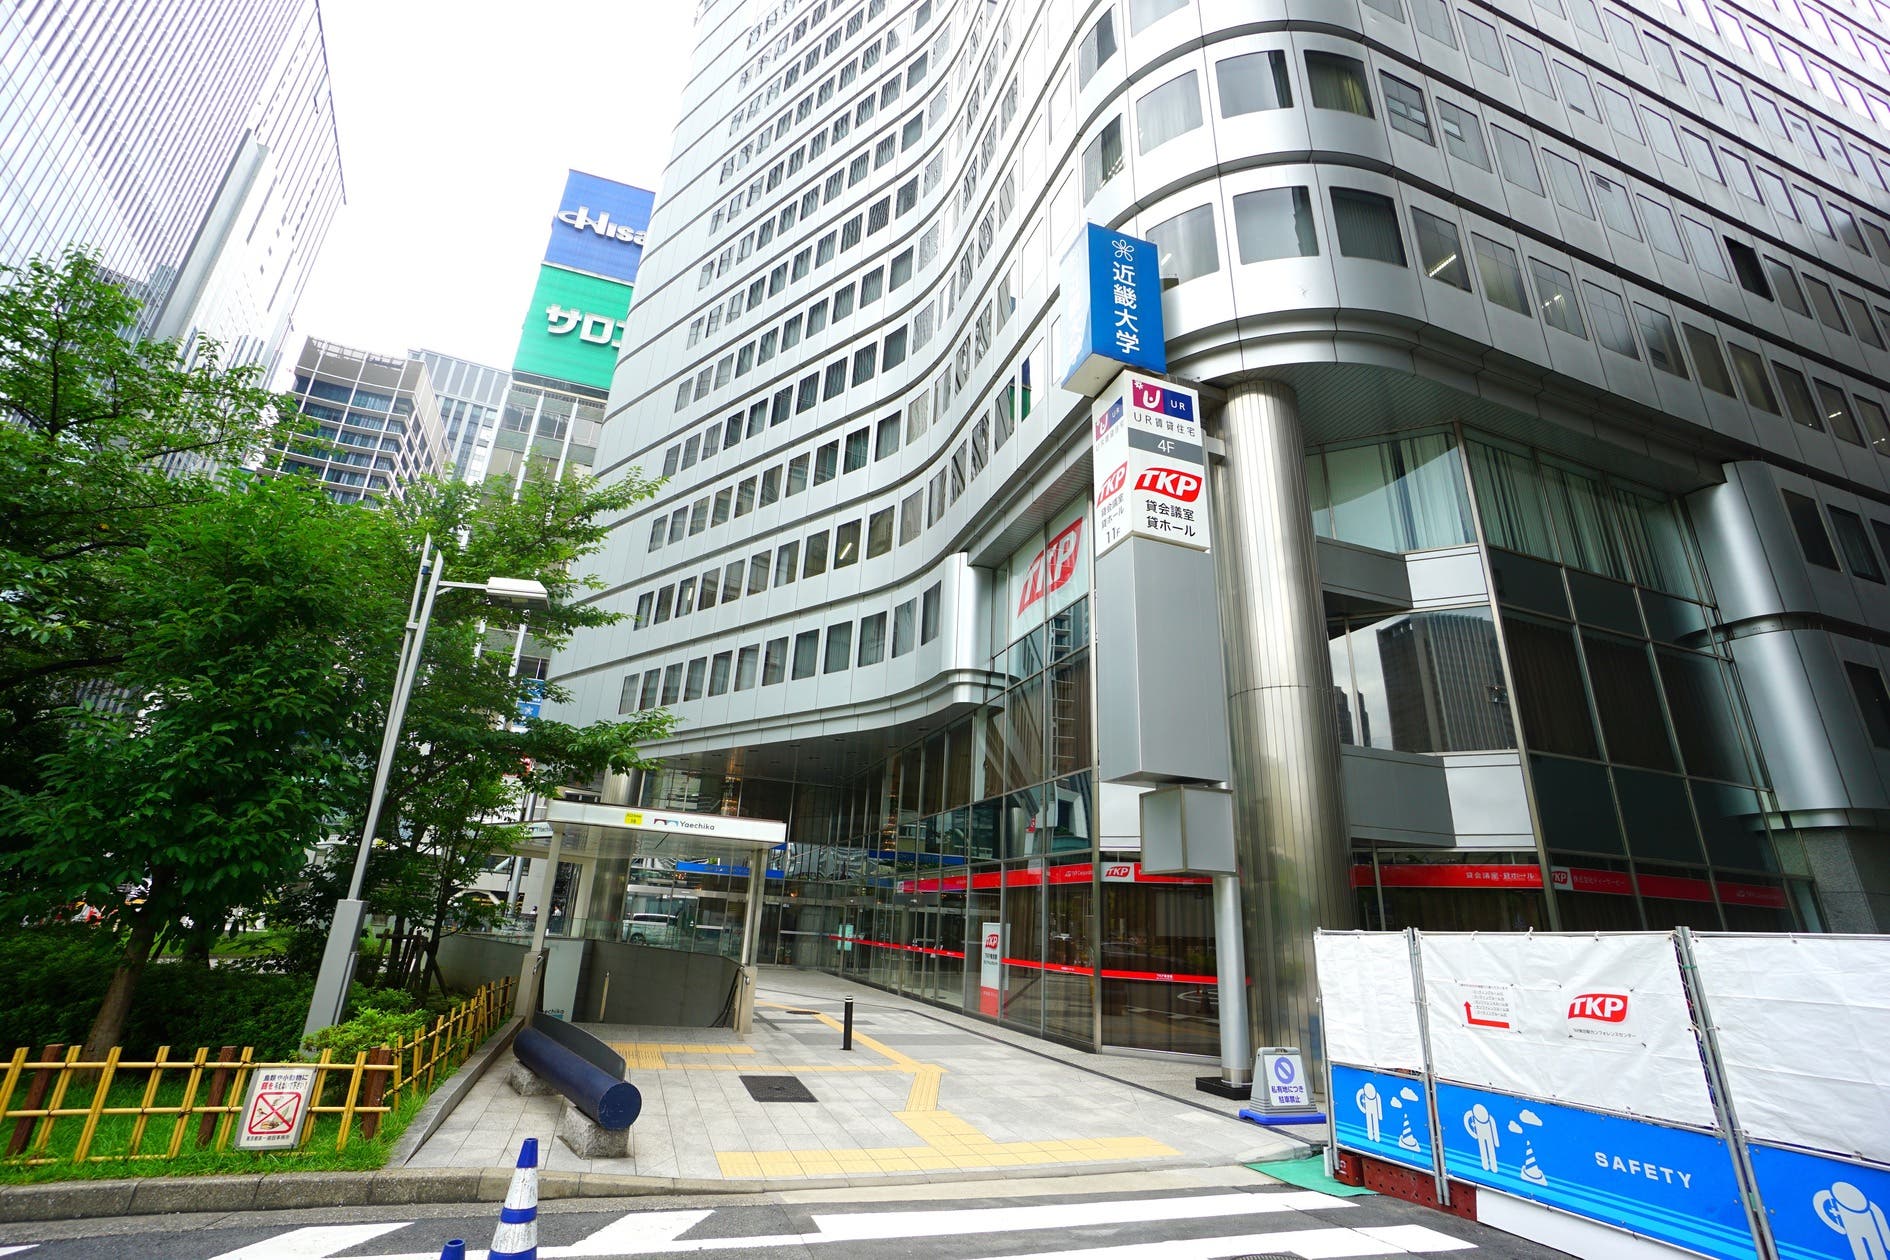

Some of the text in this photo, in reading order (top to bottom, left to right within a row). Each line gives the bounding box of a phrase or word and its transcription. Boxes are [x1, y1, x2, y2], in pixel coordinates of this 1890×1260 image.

[1113, 261, 1140, 354] 近畿大学
[1170, 400, 1186, 411] UR
[1158, 439, 1175, 454] 4F
[1098, 467, 1126, 503] TKP
[1141, 470, 1198, 497] TKP
[1145, 499, 1195, 522] 貸会議室
[1146, 515, 1196, 537] 貸ホール
[679, 820, 715, 831] Yaechika
[1108, 867, 1128, 876] TKP
[1572, 997, 1624, 1018] TKP
[1271, 1085, 1304, 1093] 私有地につき
[1278, 1095, 1301, 1104] 駐車禁止
[1595, 1151, 1692, 1189] SAFETY
